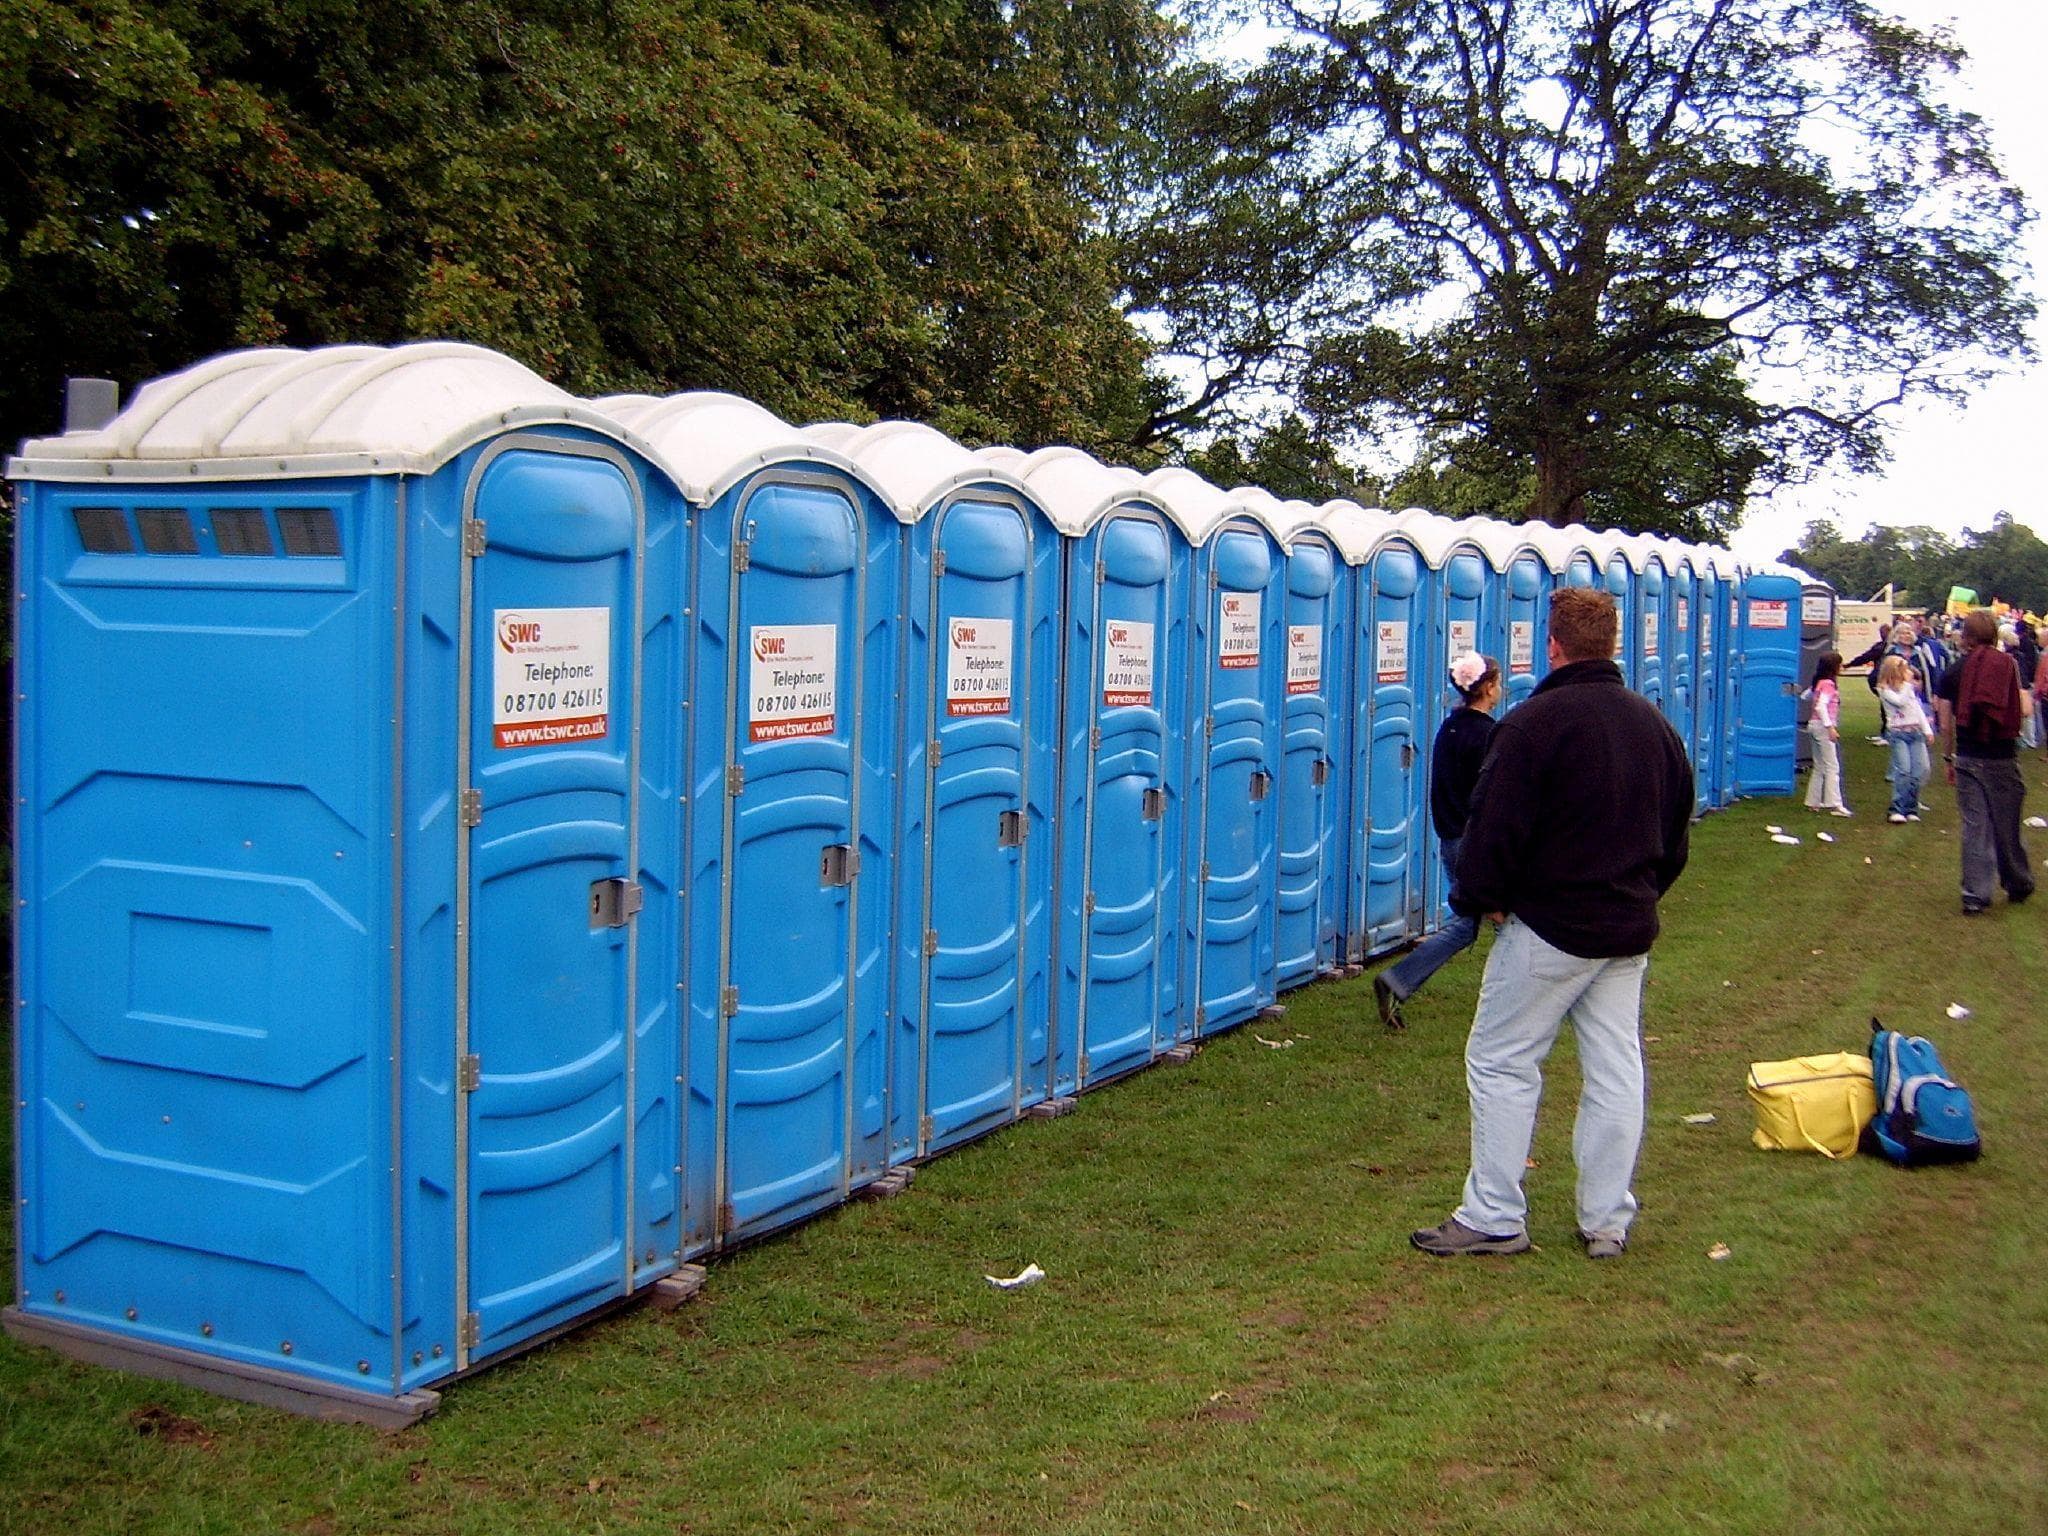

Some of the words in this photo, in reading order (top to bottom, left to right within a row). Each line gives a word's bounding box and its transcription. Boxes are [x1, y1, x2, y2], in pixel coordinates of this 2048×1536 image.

[1226, 600, 1240, 612] SWC
[508, 623, 541, 643] SWC
[957, 628, 976, 643] SWC
[1112, 629, 1128, 643] SWC
[761, 638, 785, 655] SWC
[525, 662, 594, 685] Telephone:
[773, 670, 825, 690] Telephone:
[1108, 673, 1133, 685] 08700
[953, 678, 983, 692] 08700
[986, 678, 1009, 691] 426115
[504, 692, 557, 713] 08700
[562, 688, 603, 709] 426115
[757, 695, 797, 713] 08700
[800, 692, 832, 709] 426115
[501, 717, 606, 743] www.tswc.co.uk
[755, 716, 833, 738] www.tswc.co.uk
